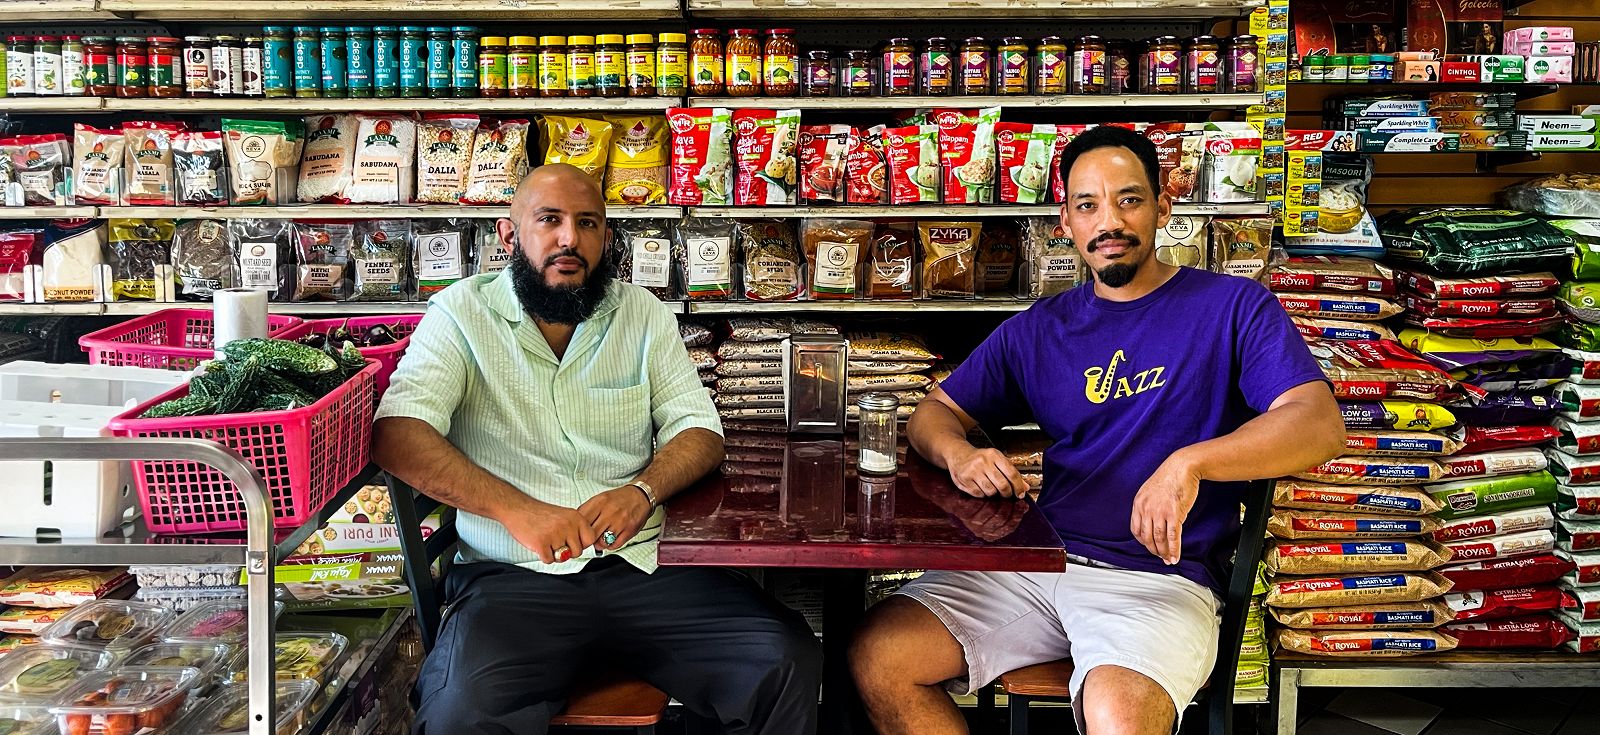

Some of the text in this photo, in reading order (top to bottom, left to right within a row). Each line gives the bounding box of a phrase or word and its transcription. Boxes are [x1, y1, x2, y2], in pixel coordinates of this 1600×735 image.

[296, 41, 304, 69] deep
[353, 41, 364, 68] deep
[378, 41, 389, 68] deep
[402, 41, 413, 68] deep
[434, 42, 445, 68] deep
[461, 41, 472, 68] deep
[673, 118, 691, 126] MTR
[738, 121, 754, 130] MTR
[1541, 121, 1569, 129] Neem
[368, 134, 394, 142] LAXMI
[1303, 132, 1323, 142] RED
[1540, 137, 1568, 145] Neem
[752, 144, 764, 152] Idli
[890, 148, 908, 156] Upma
[1001, 145, 1016, 153] pma
[1214, 143, 1231, 152] MTR
[304, 152, 340, 162] SABUDANA
[428, 166, 456, 174] DALIA
[1326, 167, 1362, 176] MASOORI
[930, 228, 969, 239] ZYKA
[261, 258, 272, 266] SEED
[1280, 278, 1310, 286] ROYAL
[1462, 286, 1496, 295] ROYAL
[1462, 304, 1492, 313] ROYAL
[1350, 386, 1382, 396] ROYAL
[1330, 465, 1355, 474] ROYAL
[1450, 458, 1537, 476] ROYAL SELLA
[1320, 494, 1346, 503] ROYAL
[1319, 522, 1344, 530] ROYAL
[1458, 524, 1491, 537] ROYAL
[344, 527, 399, 540] ANI PURI
[1305, 546, 1331, 554] ROYAL
[1458, 547, 1490, 558] ROYAL
[1516, 558, 1535, 566] LONG
[310, 565, 396, 581] NANAK Kaju Roll
[1494, 588, 1516, 596] EXTRA
[1339, 615, 1363, 624] ROYAL
[1498, 623, 1519, 631] EXTRA
[1335, 642, 1360, 650] ROYAL
